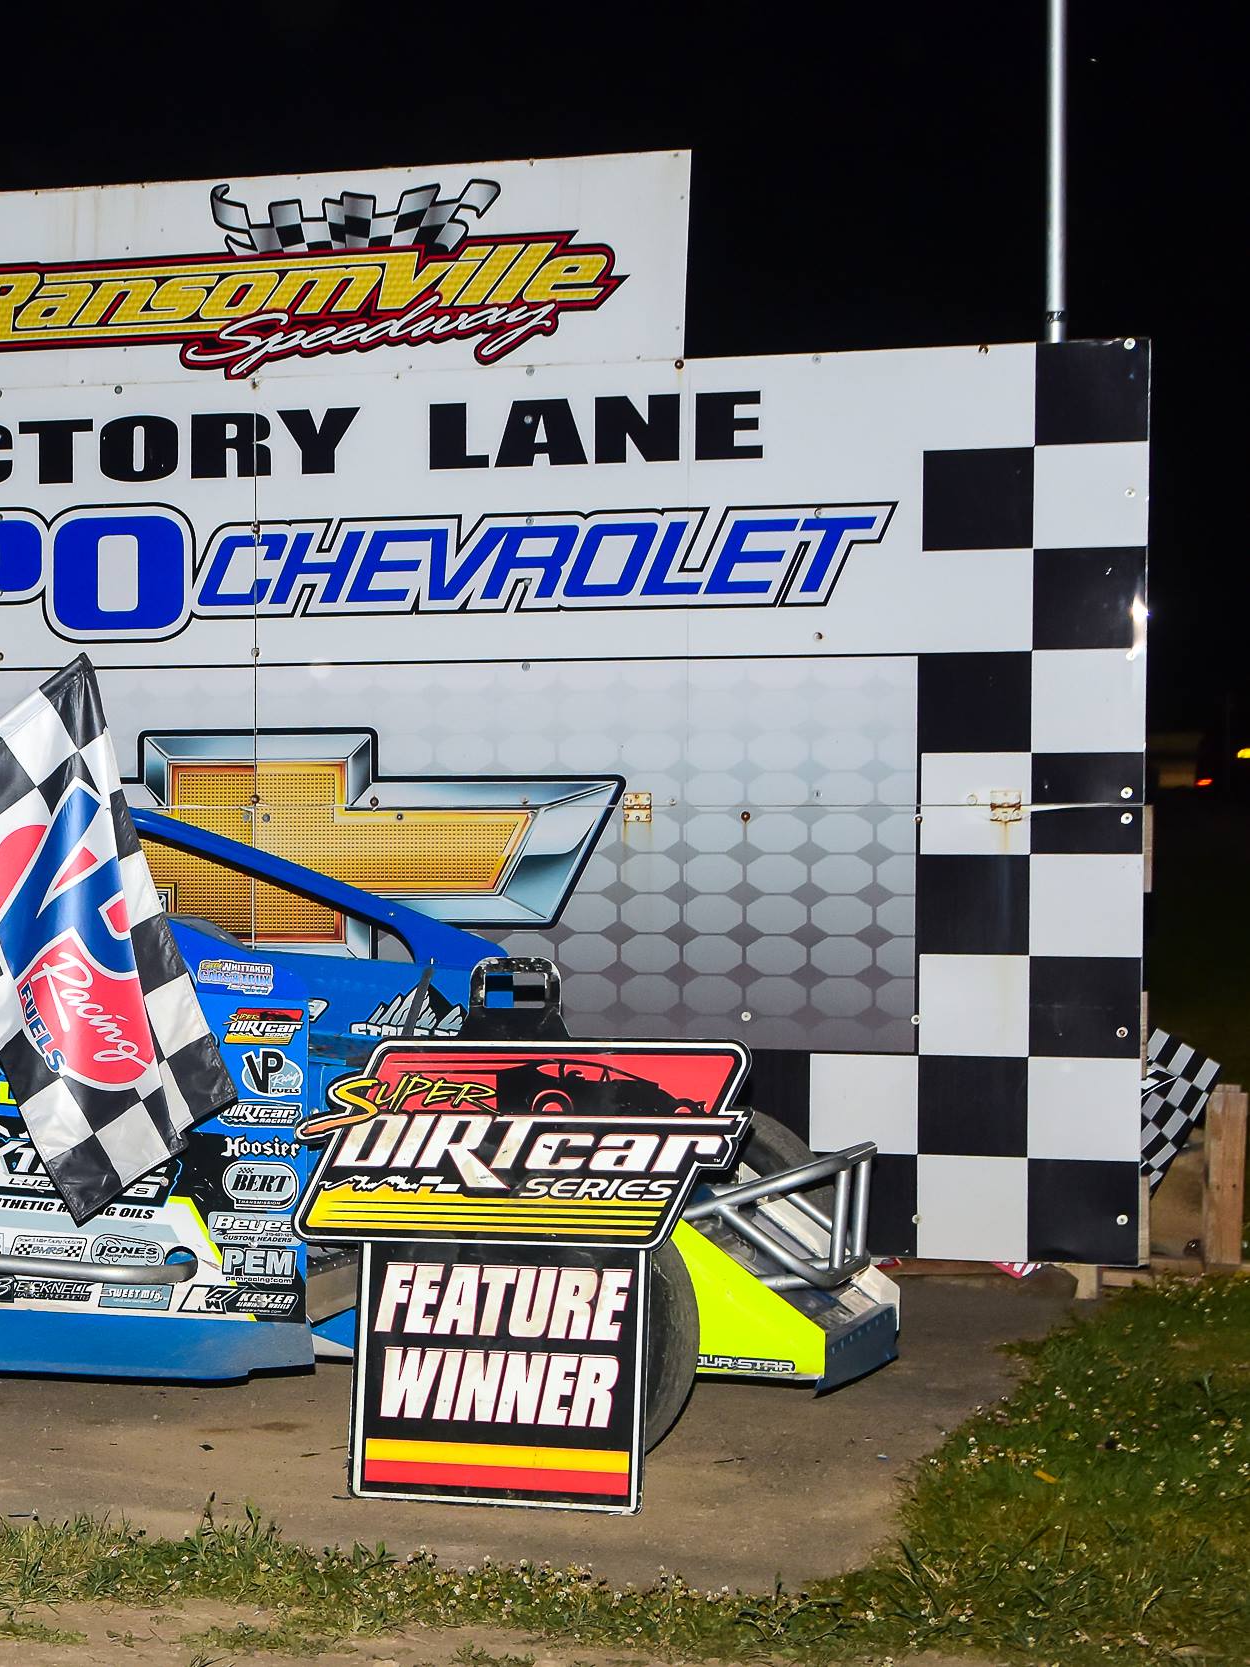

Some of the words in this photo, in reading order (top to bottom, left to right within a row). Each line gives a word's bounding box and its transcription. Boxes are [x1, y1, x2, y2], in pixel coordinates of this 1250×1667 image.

[181, 298, 557, 374] Speedway
[429, 391, 764, 469] LANE
[197, 512, 878, 608] CHEVROLET
[222, 962, 271, 973] WHITTAKER
[32, 951, 150, 1063] Racing
[20, 983, 67, 1073] FUELS
[229, 1021, 303, 1036] DIRTcar
[245, 1050, 284, 1094] VP
[300, 1071, 498, 1138] SUPER
[221, 1136, 300, 1158] Hoosier
[332, 1114, 734, 1190] DIRTcar
[231, 1174, 291, 1192] BERT
[519, 1177, 680, 1200] SERIES
[119, 1207, 154, 1219] OILS
[31, 1246, 64, 1255] BMRS
[95, 1245, 158, 1257] JONES
[223, 1248, 292, 1275] PEM
[225, 1276, 292, 1284] pemracing.com
[108, 1288, 140, 1298] SWEET
[373, 1262, 633, 1342] FEATURE
[736, 1359, 795, 1372] STAR
[379, 1347, 620, 1429] WINNER
